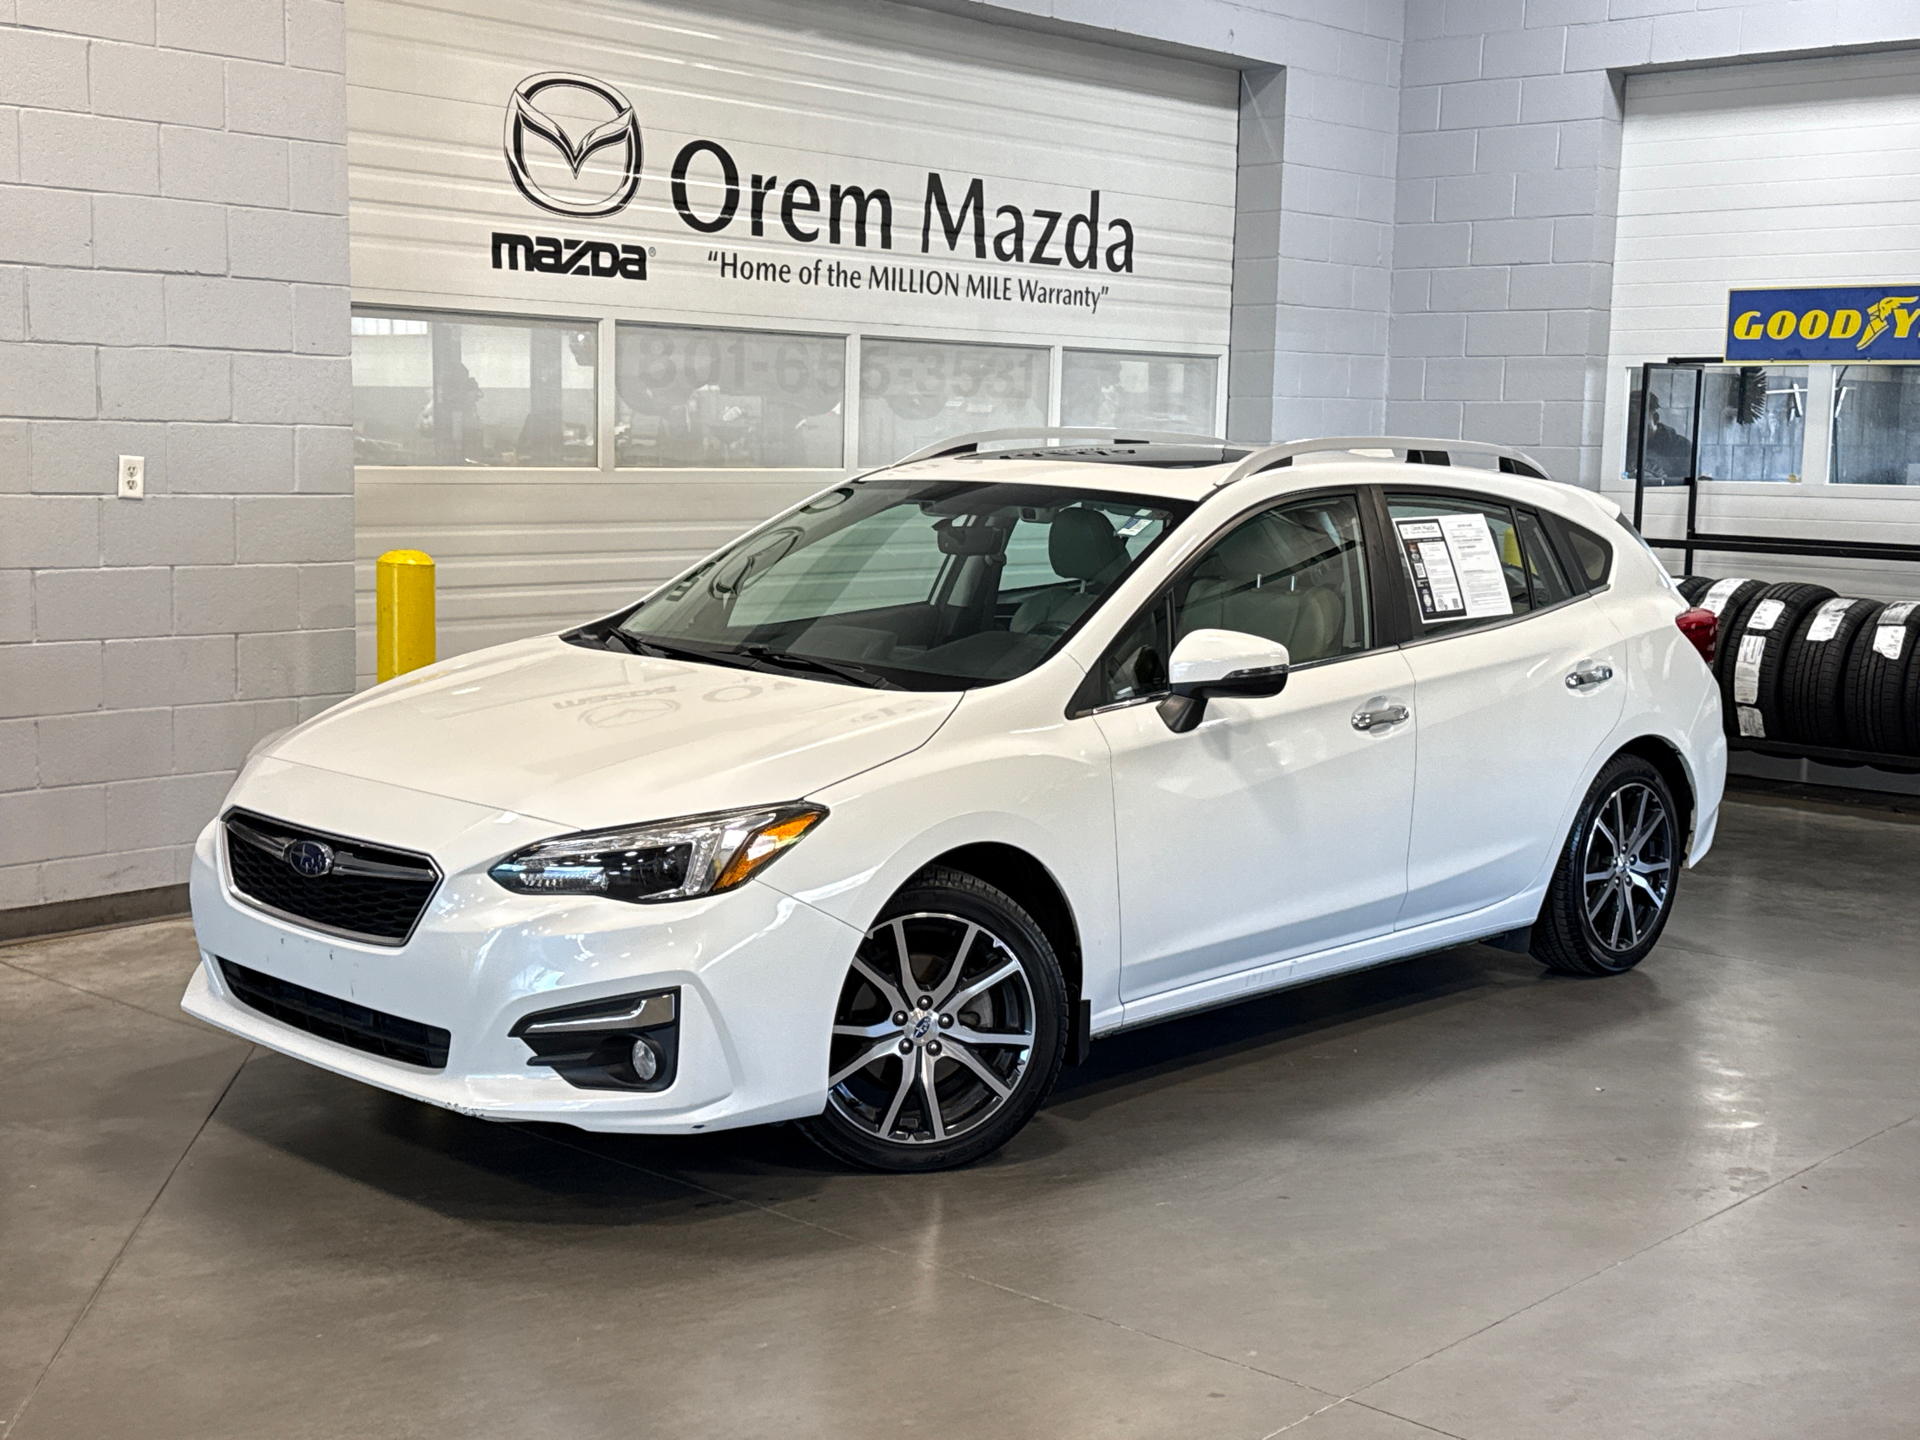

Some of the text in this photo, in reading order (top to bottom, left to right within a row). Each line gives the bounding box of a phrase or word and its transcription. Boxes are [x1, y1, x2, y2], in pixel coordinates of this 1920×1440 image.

[671, 139, 1134, 273] Orem Mazda
[799, 259, 823, 285] of
[827, 261, 862, 288] the
[868, 265, 959, 297] MILLION
[965, 274, 1012, 301] MILE
[1733, 308, 1920, 340] GOODY
